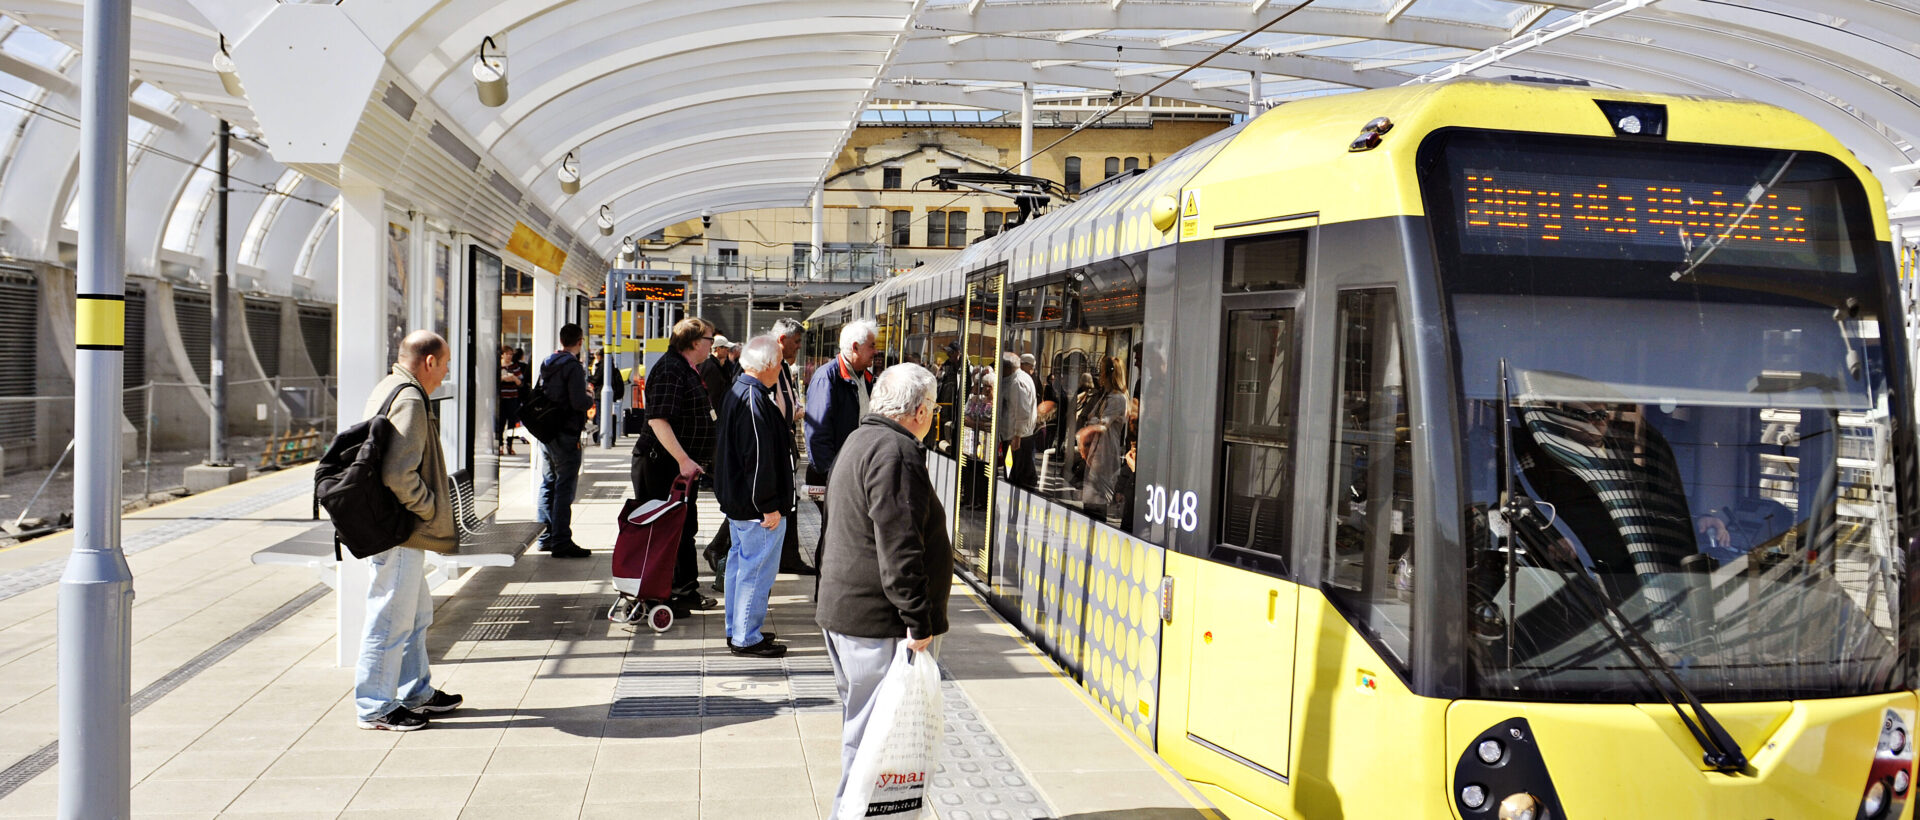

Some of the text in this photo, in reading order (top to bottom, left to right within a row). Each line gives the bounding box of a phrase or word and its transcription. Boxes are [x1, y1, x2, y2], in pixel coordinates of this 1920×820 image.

[1467, 175, 1562, 241] Bury
[1572, 183, 1638, 234] via
[1144, 484, 1198, 532] 3048
